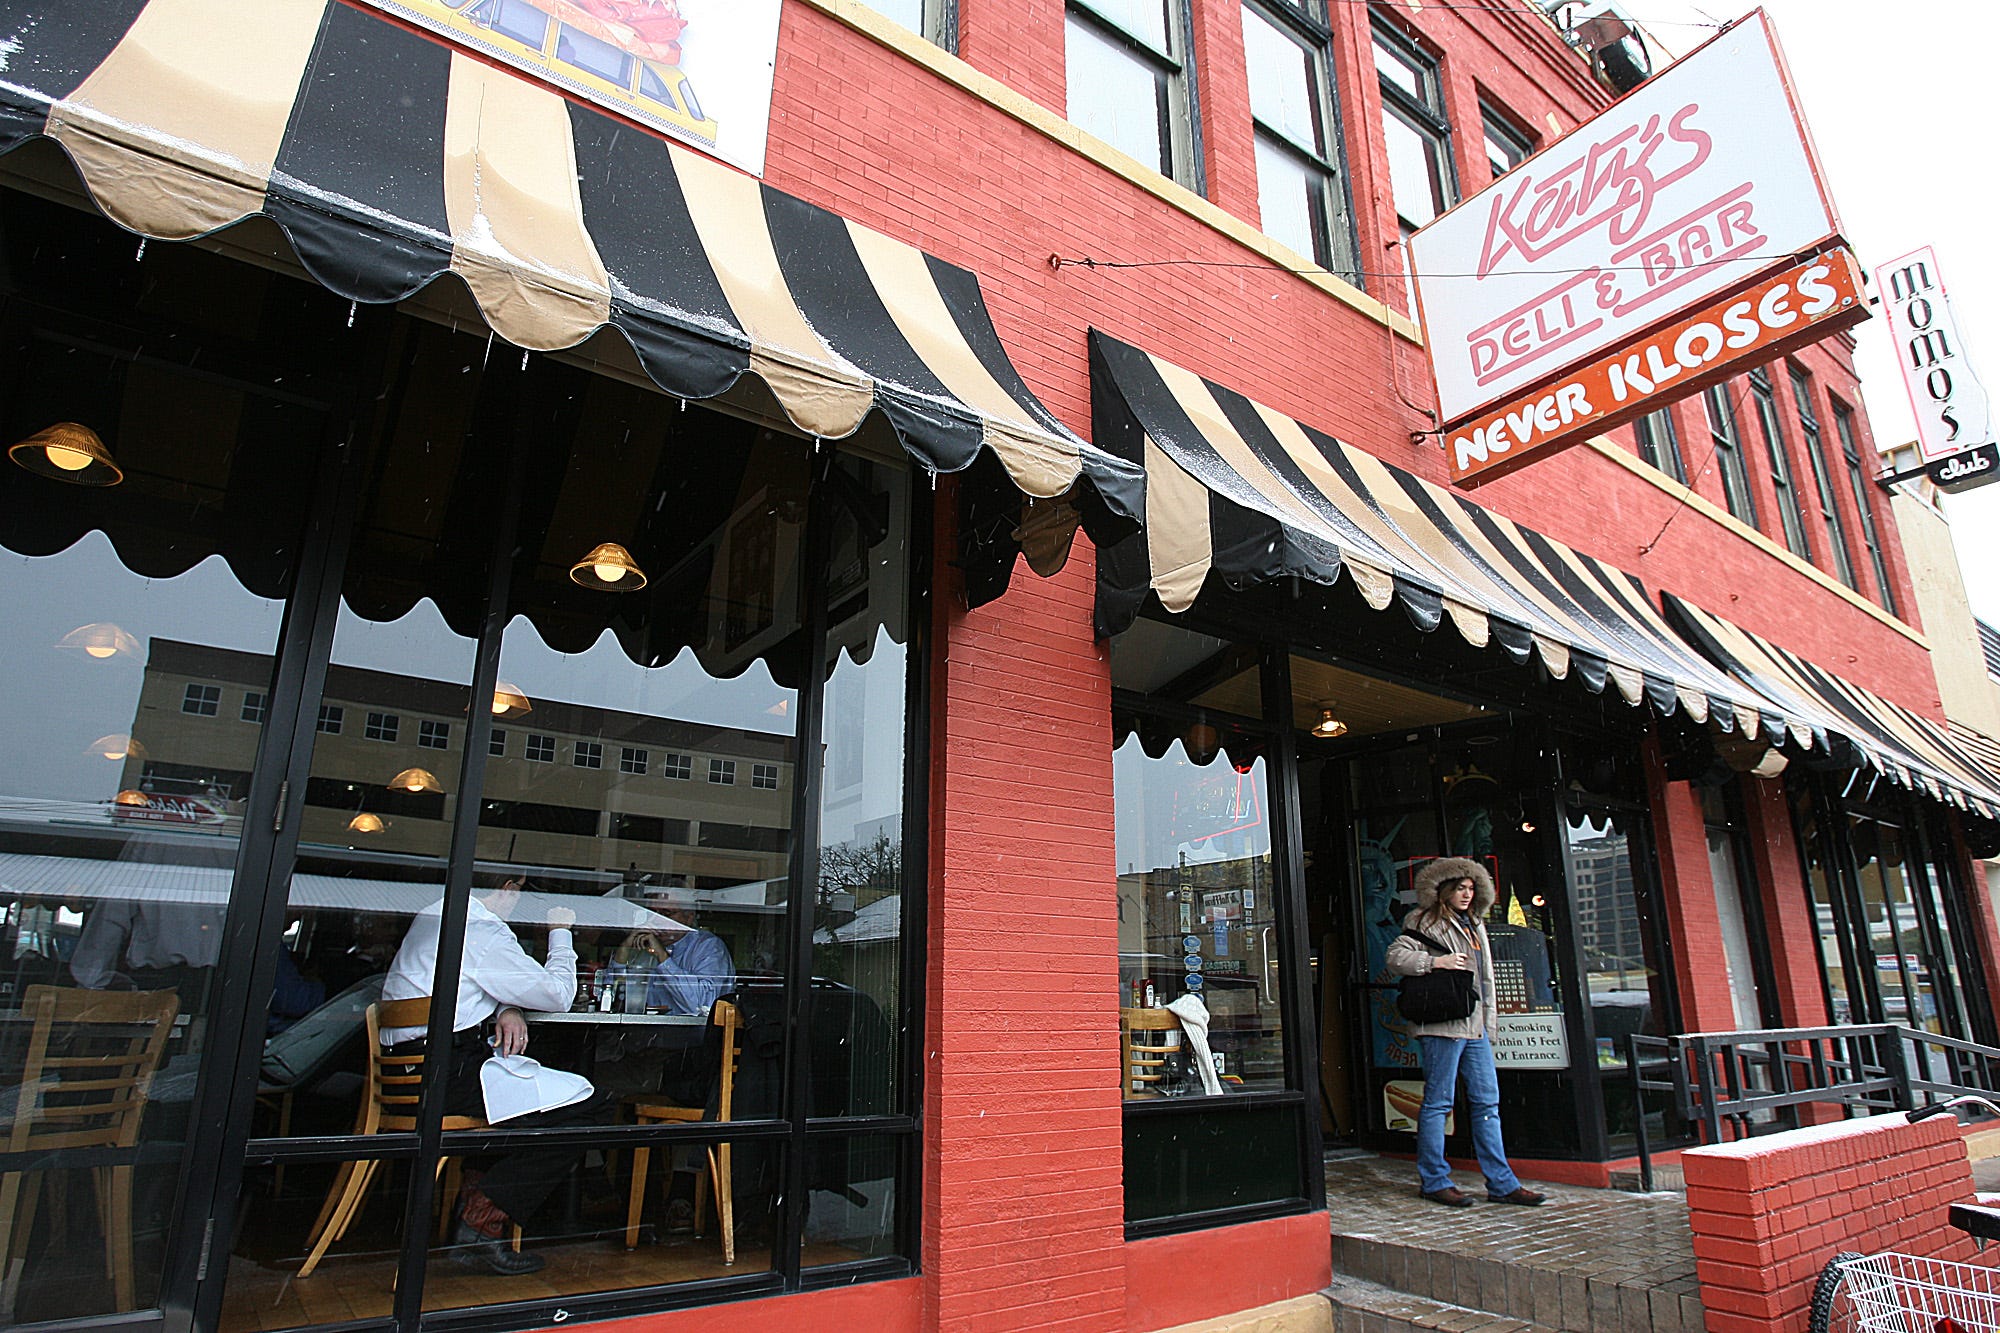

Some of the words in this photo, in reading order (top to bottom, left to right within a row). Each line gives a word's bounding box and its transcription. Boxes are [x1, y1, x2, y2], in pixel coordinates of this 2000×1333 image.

[1477, 103, 1713, 281] Katz's
[1469, 294, 1576, 378] DELI
[1640, 201, 1759, 287] BAR
[1454, 382, 1594, 472] NEVER
[1607, 265, 1838, 401] KLOSES
[1939, 451, 1990, 481] club
[1498, 1037, 1523, 1047] ithin
[1526, 1037, 1537, 1047] 15
[1540, 1036, 1561, 1046] Feet
[1508, 1023, 1553, 1034] Smoking
[1495, 1051, 1508, 1061] Of
